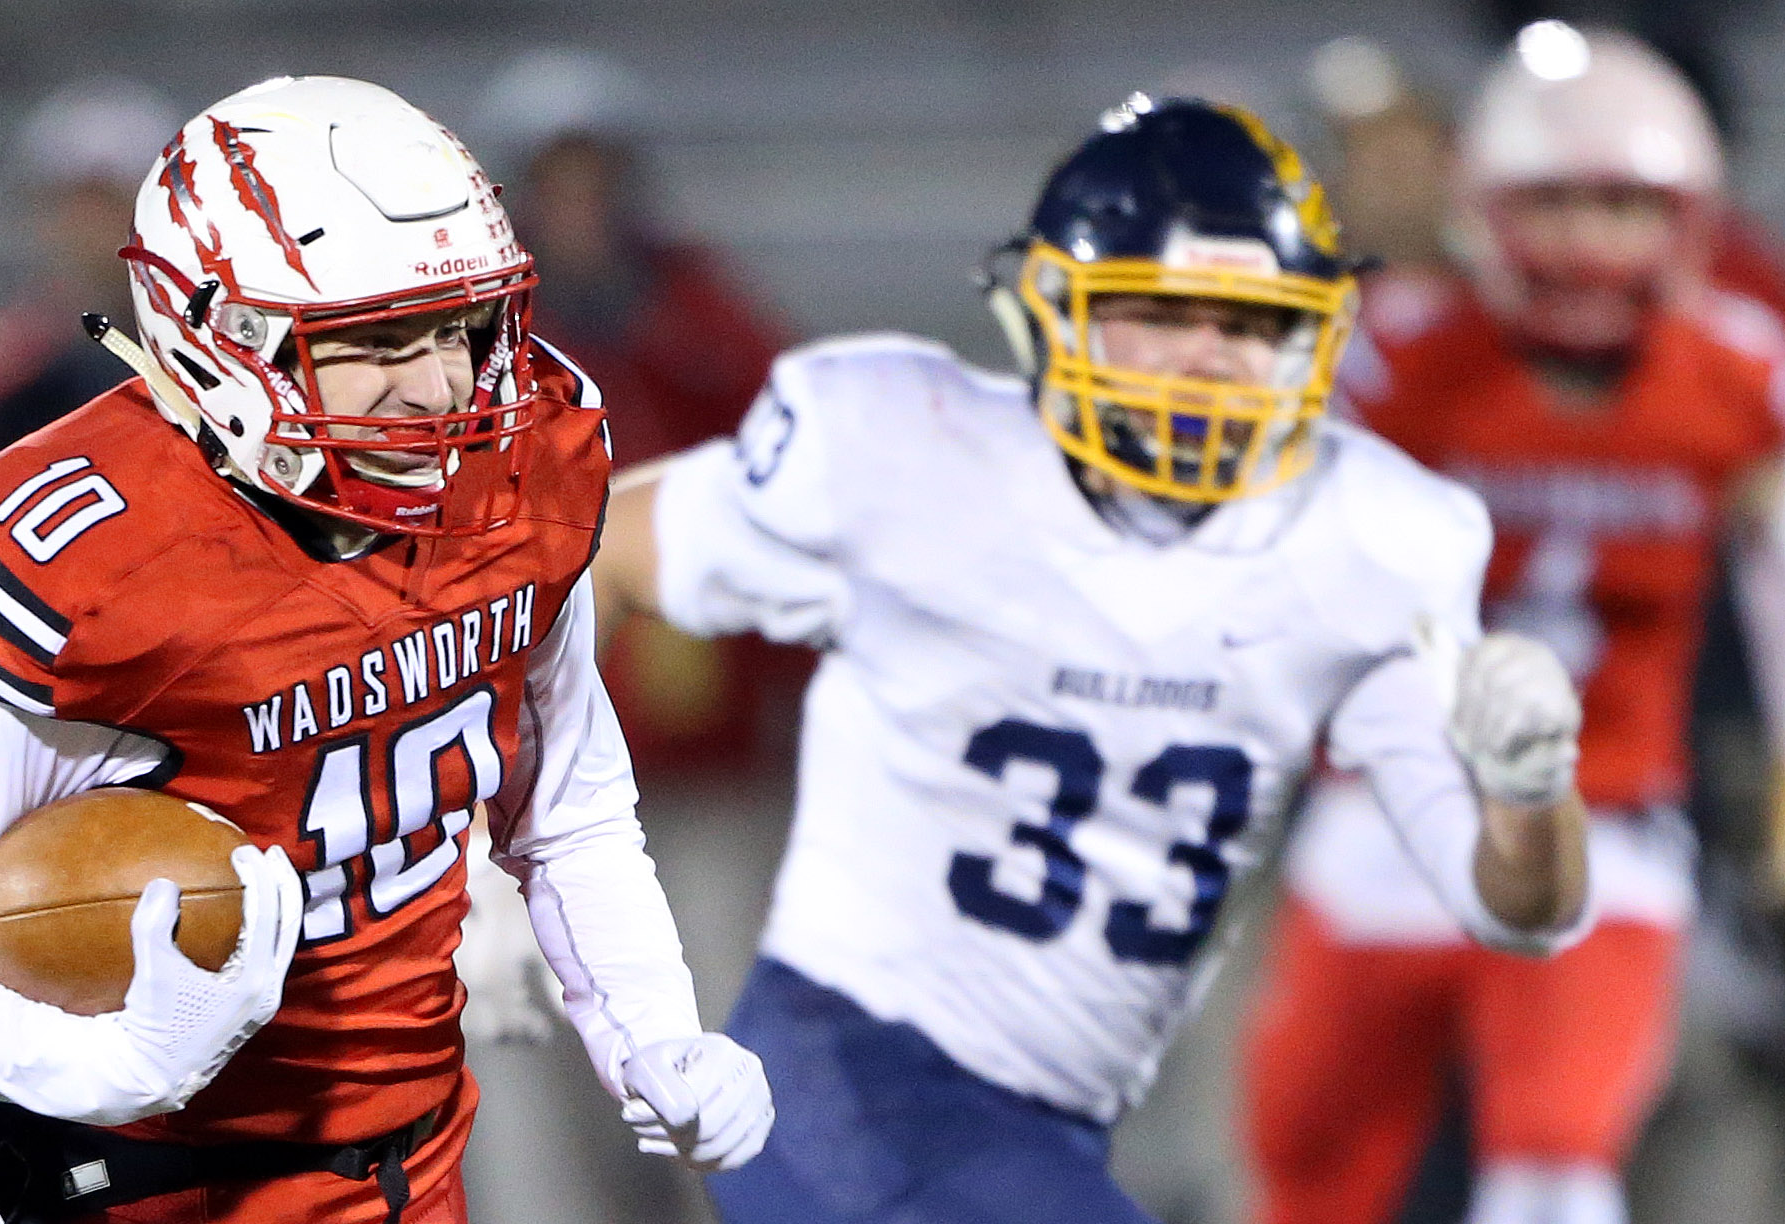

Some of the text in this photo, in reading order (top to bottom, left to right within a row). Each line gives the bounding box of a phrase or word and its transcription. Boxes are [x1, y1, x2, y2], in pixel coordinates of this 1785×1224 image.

[242, 583, 536, 754] WADSWORTH
[299, 684, 503, 943] 10
[947, 716, 1254, 966] 33
